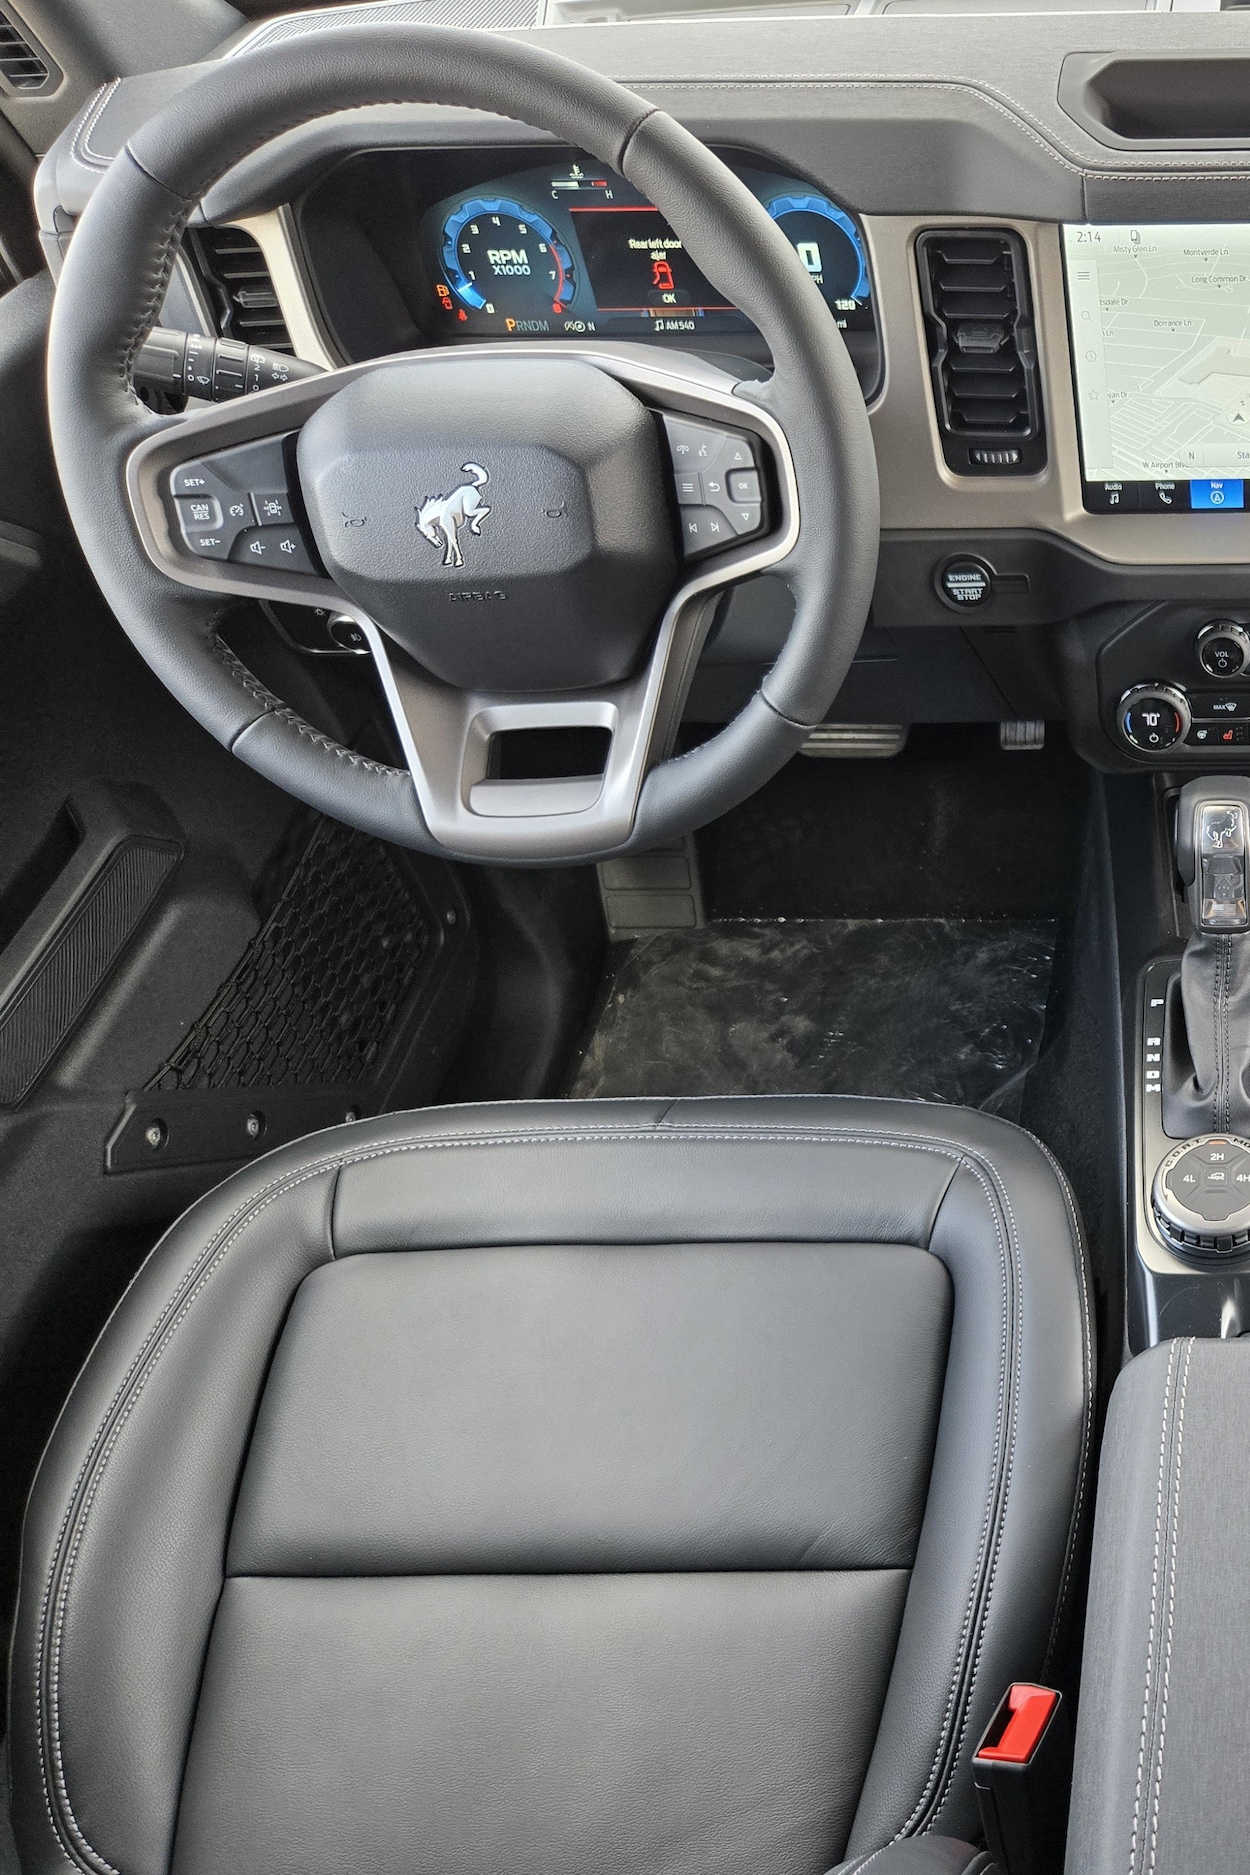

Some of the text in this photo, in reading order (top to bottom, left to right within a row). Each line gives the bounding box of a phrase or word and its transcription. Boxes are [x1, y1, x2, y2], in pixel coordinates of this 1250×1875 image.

[552, 191, 559, 199] C
[605, 190, 613, 199] H
[492, 217, 500, 226] 4
[470, 225, 479, 234] 3
[519, 225, 527, 234] 5
[1077, 231, 1101, 242] 2:14
[539, 244, 547, 252] 6
[628, 238, 682, 249] Rear left door
[462, 244, 470, 253] 2
[487, 250, 528, 264] RPM
[651, 250, 667, 261] ajar
[797, 243, 822, 272] 0
[469, 271, 475, 280] 1
[492, 266, 530, 276] X1000
[549, 271, 556, 280] 7
[1191, 276, 1207, 284] Long
[662, 293, 676, 303] OK
[486, 304, 494, 313] 0
[835, 299, 856, 310] 120
[588, 323, 596, 331] N
[667, 321, 695, 330] AM 540
[1105, 483, 1122, 491] Audio
[1155, 482, 1175, 490] Phone
[194, 512, 210, 520] RES
[1150, 999, 1164, 1007] P
[1147, 1037, 1161, 1046] R
[1146, 1053, 1160, 1062] N
[1146, 1071, 1160, 1079] D
[1146, 1084, 1161, 1092] M
[1210, 1153, 1224, 1161] 2H
[1183, 1174, 1196, 1182] 4L
[1236, 1174, 1250, 1182] 4H
